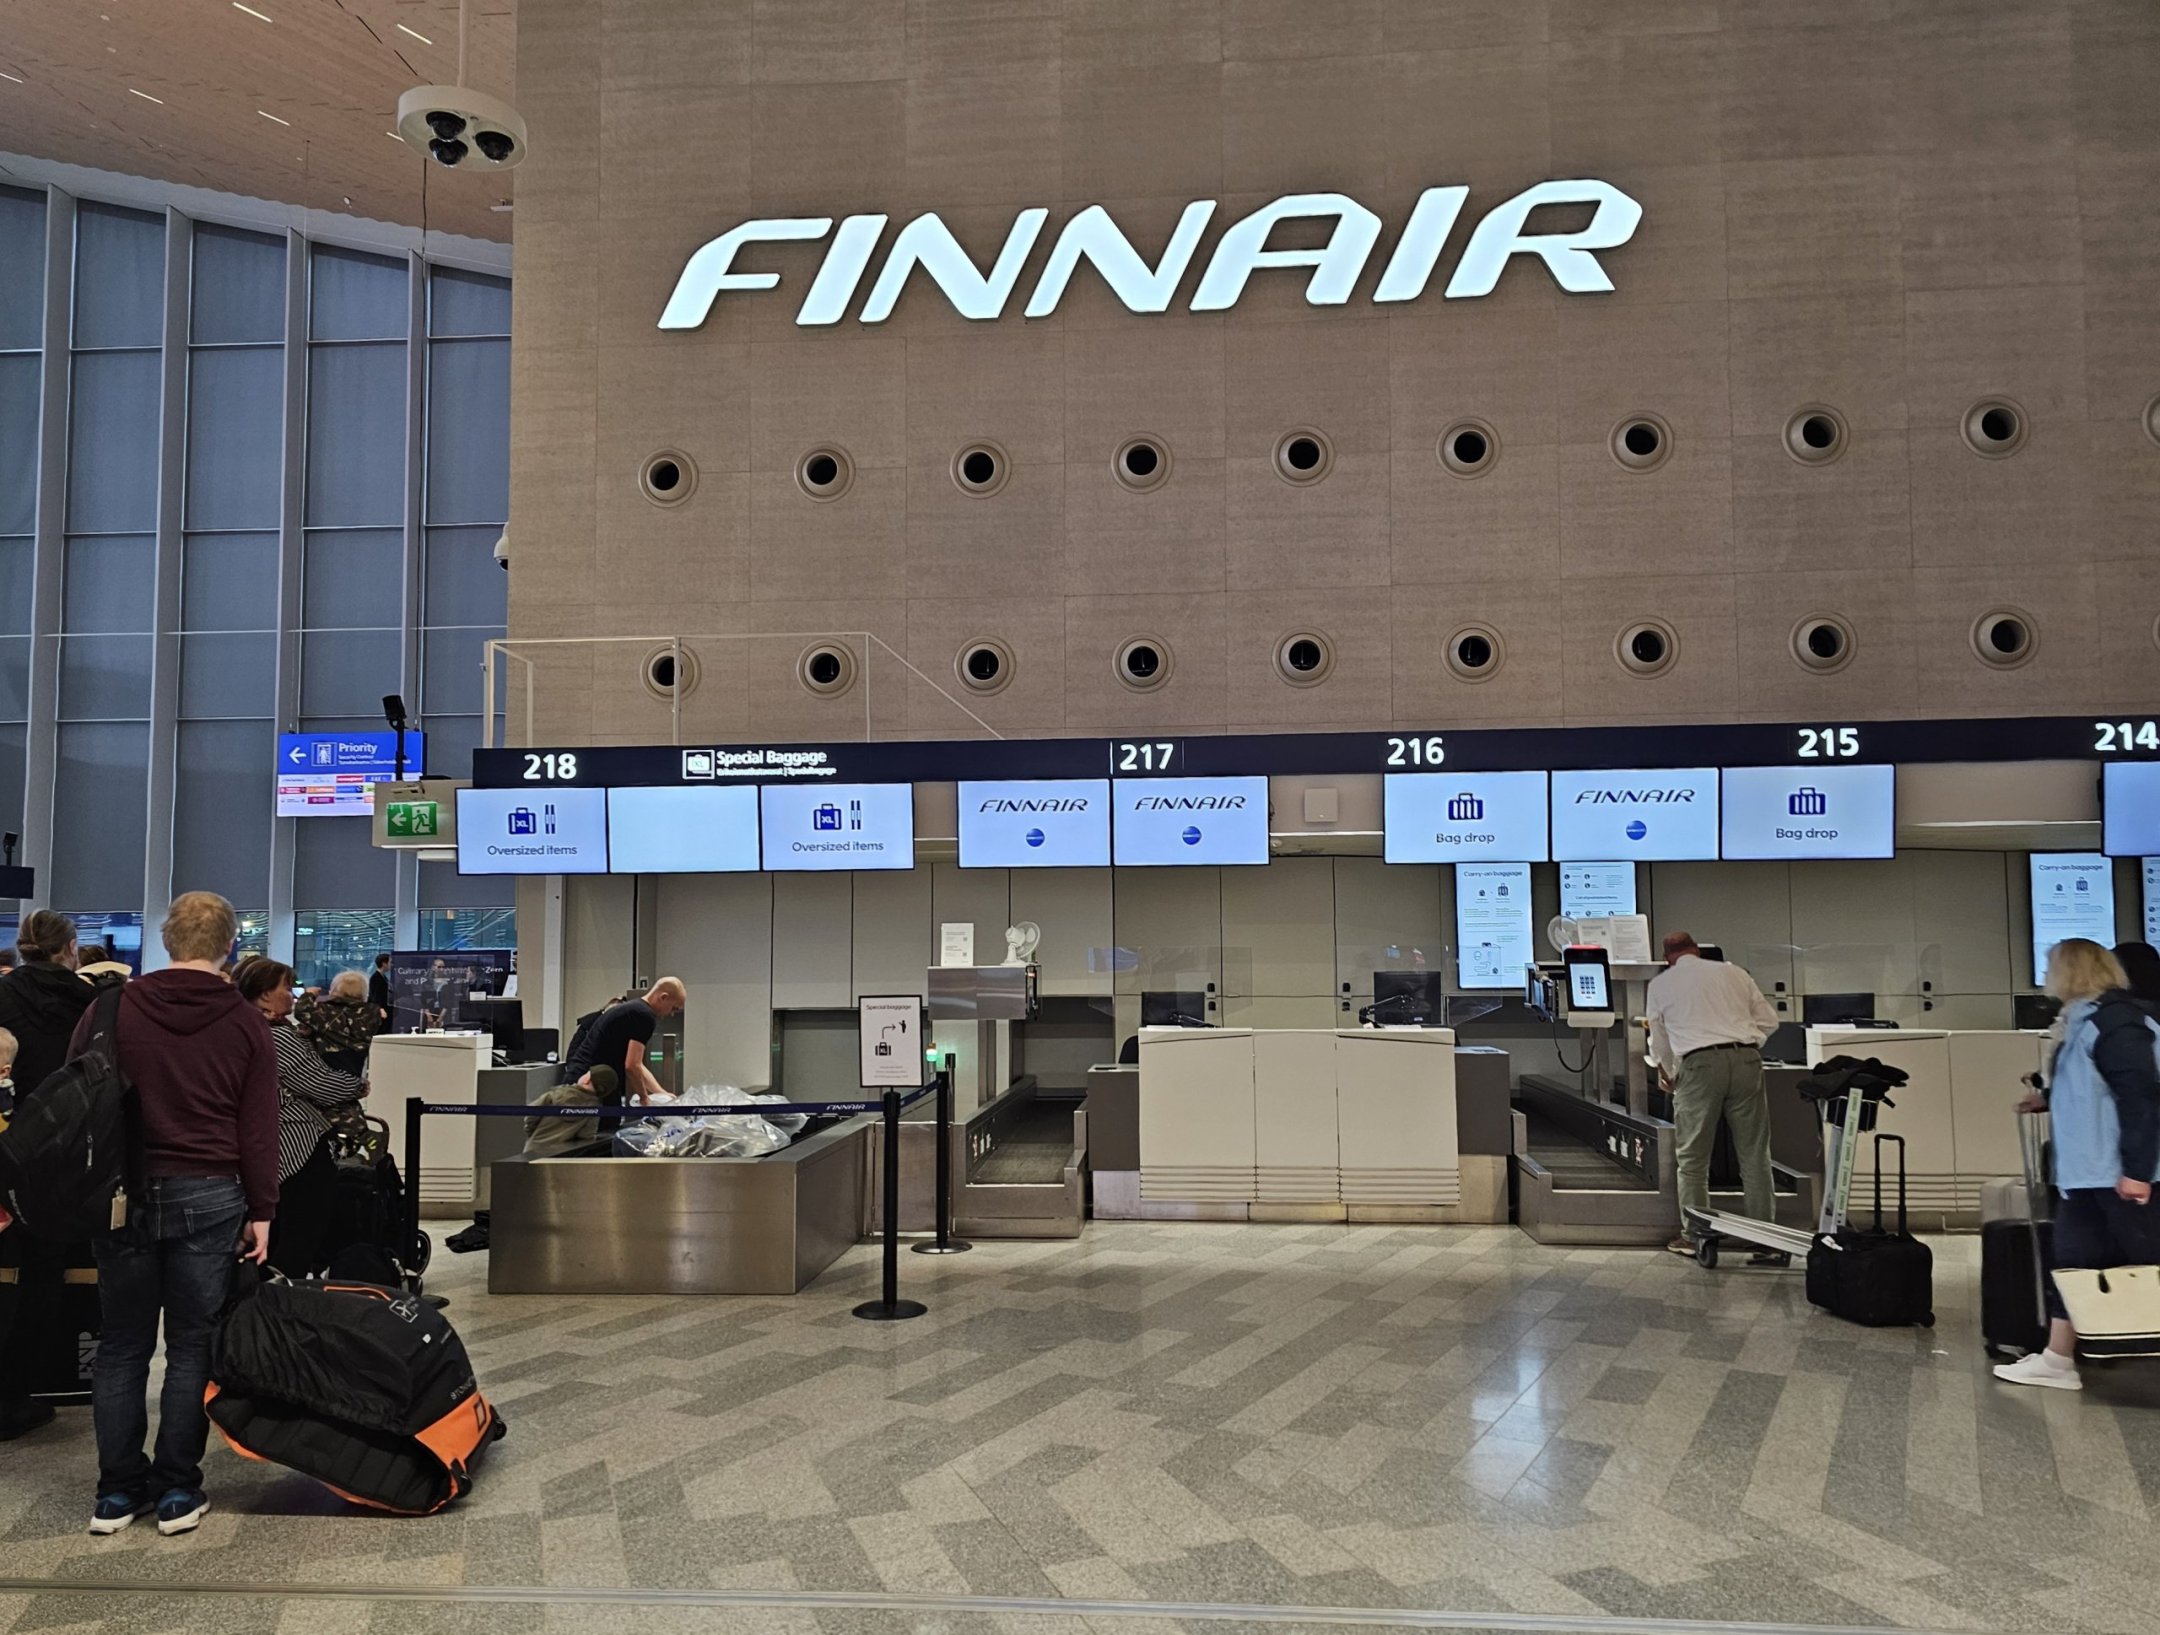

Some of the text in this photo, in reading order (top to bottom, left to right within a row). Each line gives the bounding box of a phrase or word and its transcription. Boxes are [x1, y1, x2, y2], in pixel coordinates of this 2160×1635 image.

[657, 179, 1643, 330] FINNAIR
[1798, 727, 1860, 758] 215
[2094, 721, 2160, 751] 214
[338, 742, 378, 755] Priority
[1386, 736, 1445, 766] 216
[716, 750, 828, 767] Special Baggage
[1119, 743, 1174, 771] 217
[523, 753, 577, 780] 218
[1134, 795, 1247, 812] FINNAIR
[1575, 788, 1696, 804] FINNAIR
[979, 798, 1089, 813] FINNAIR
[1436, 832, 1496, 846] Bag drop
[1775, 827, 1839, 841] Bag drop
[486, 845, 578, 857] Oversized items
[791, 841, 884, 853] Oversized items
[866, 1003, 912, 1012] Special baggage
[826, 1103, 866, 1111] FINNAIR
